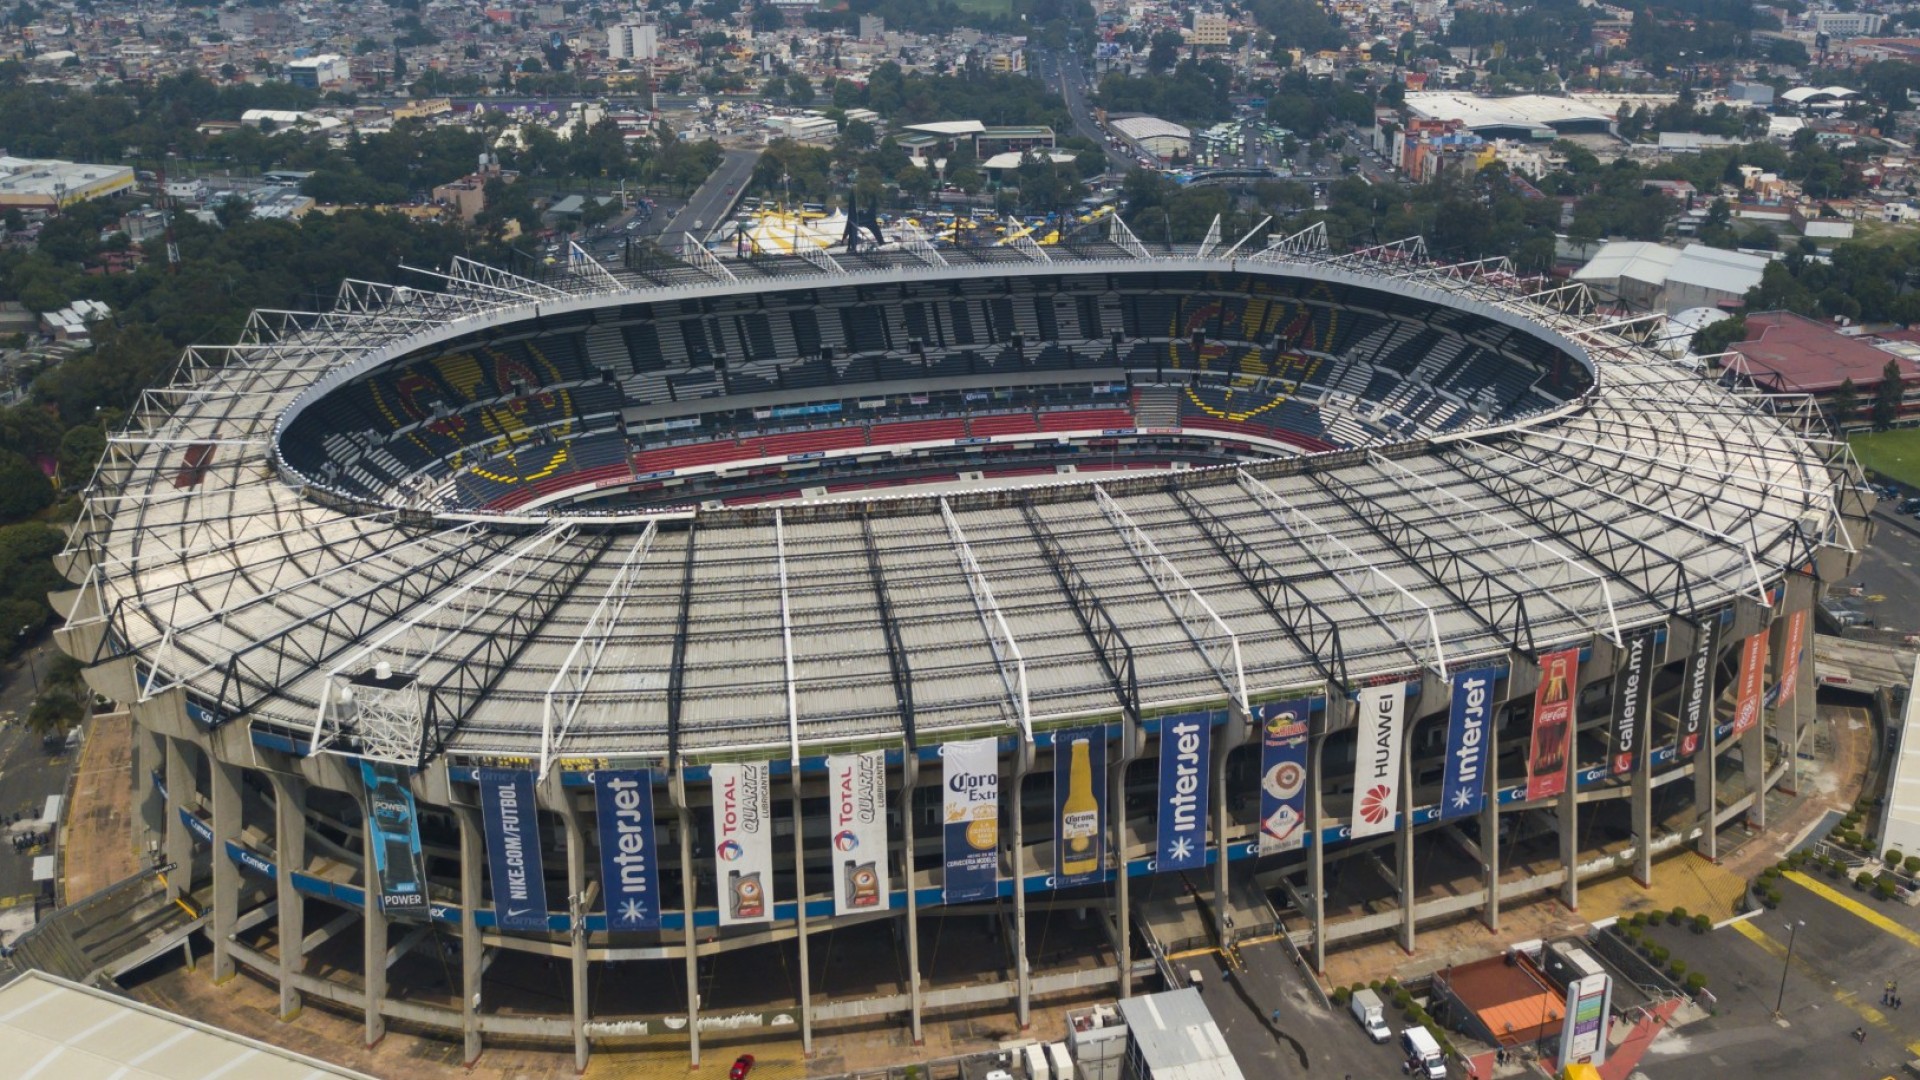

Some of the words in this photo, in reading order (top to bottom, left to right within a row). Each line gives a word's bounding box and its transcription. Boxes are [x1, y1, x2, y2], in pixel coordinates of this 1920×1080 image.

[1619, 637, 1645, 752] caliente.mx
[1374, 693, 1393, 778] HUAWEI
[723, 776, 737, 836] TOTAL
[741, 764, 759, 834] QUARTZ
[761, 765, 770, 818] LUBRICANTES
[839, 766, 853, 826] TOTAL
[857, 754, 875, 824] QUARTZ
[876, 755, 885, 808] LUBRICANTES
[949, 772, 998, 794] Coro
[969, 789, 998, 801] Extr
[190, 818, 212, 840] Comex
[498, 783, 528, 900] NIKE.COM/FUTBOL
[1065, 813, 1095, 825] Corona
[241, 852, 270, 873] Comex
[385, 894, 422, 905] POWER
